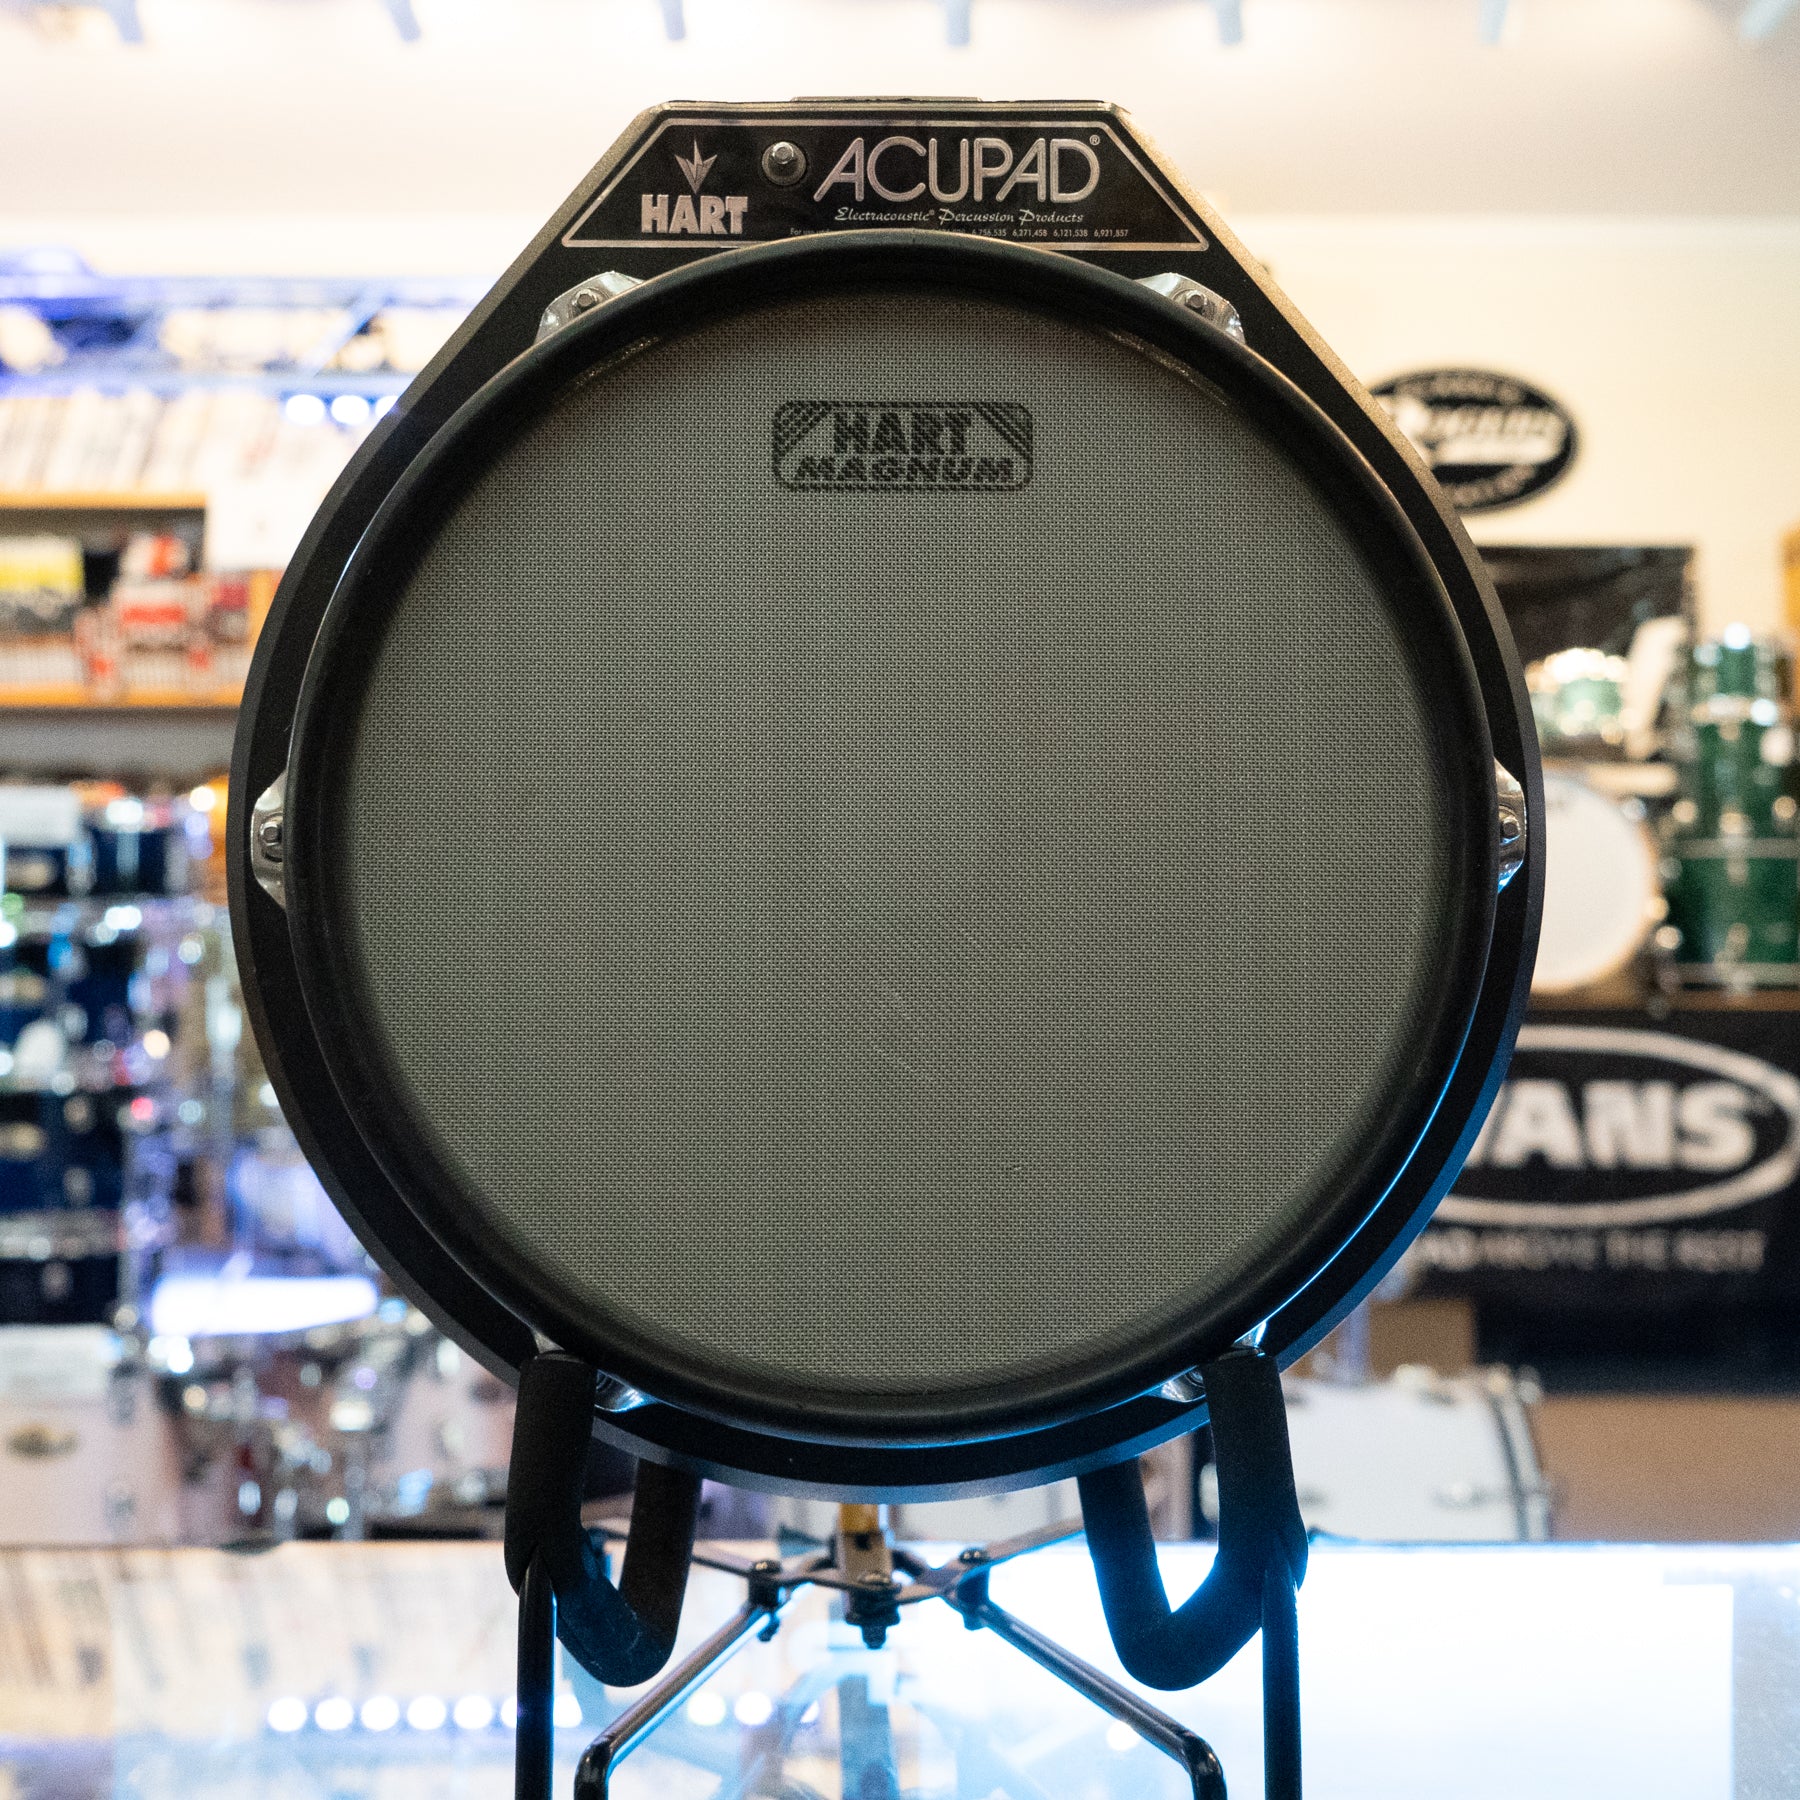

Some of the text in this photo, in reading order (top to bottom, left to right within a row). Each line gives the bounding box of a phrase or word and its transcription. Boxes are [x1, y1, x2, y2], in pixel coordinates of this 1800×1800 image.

[641, 194, 748, 234] HART
[938, 208, 1014, 225] Percussion
[1019, 208, 1083, 225] Products
[971, 228, 1007, 238] 6756,535
[1012, 228, 1048, 238] 6,271,458
[1053, 228, 1088, 238] 6,121,538
[833, 412, 972, 454] HART
[796, 456, 1014, 483] MAGNUM
